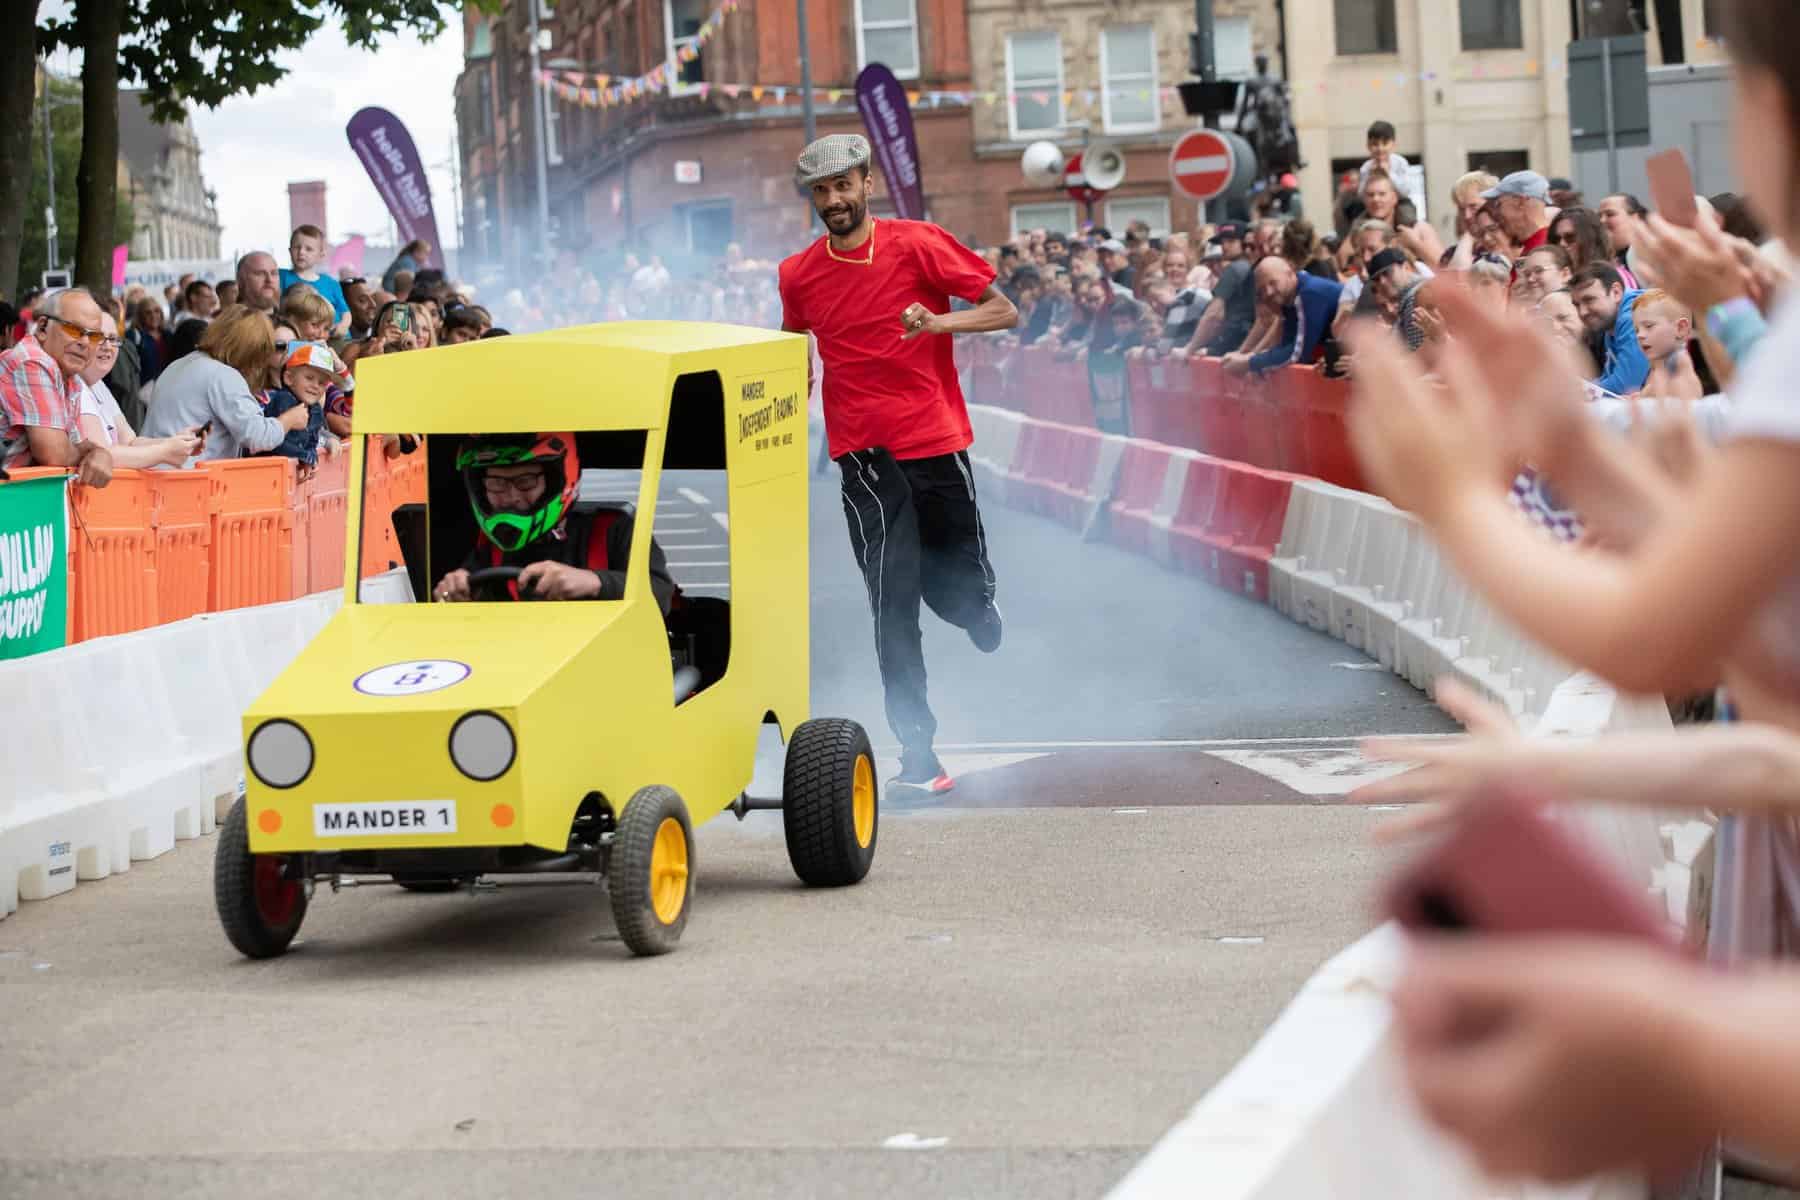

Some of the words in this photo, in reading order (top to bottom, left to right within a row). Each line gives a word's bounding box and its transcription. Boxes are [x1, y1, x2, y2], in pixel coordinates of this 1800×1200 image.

[371, 126, 406, 174] hello
[323, 808, 427, 830] MANDER
[437, 807, 449, 827] 1
